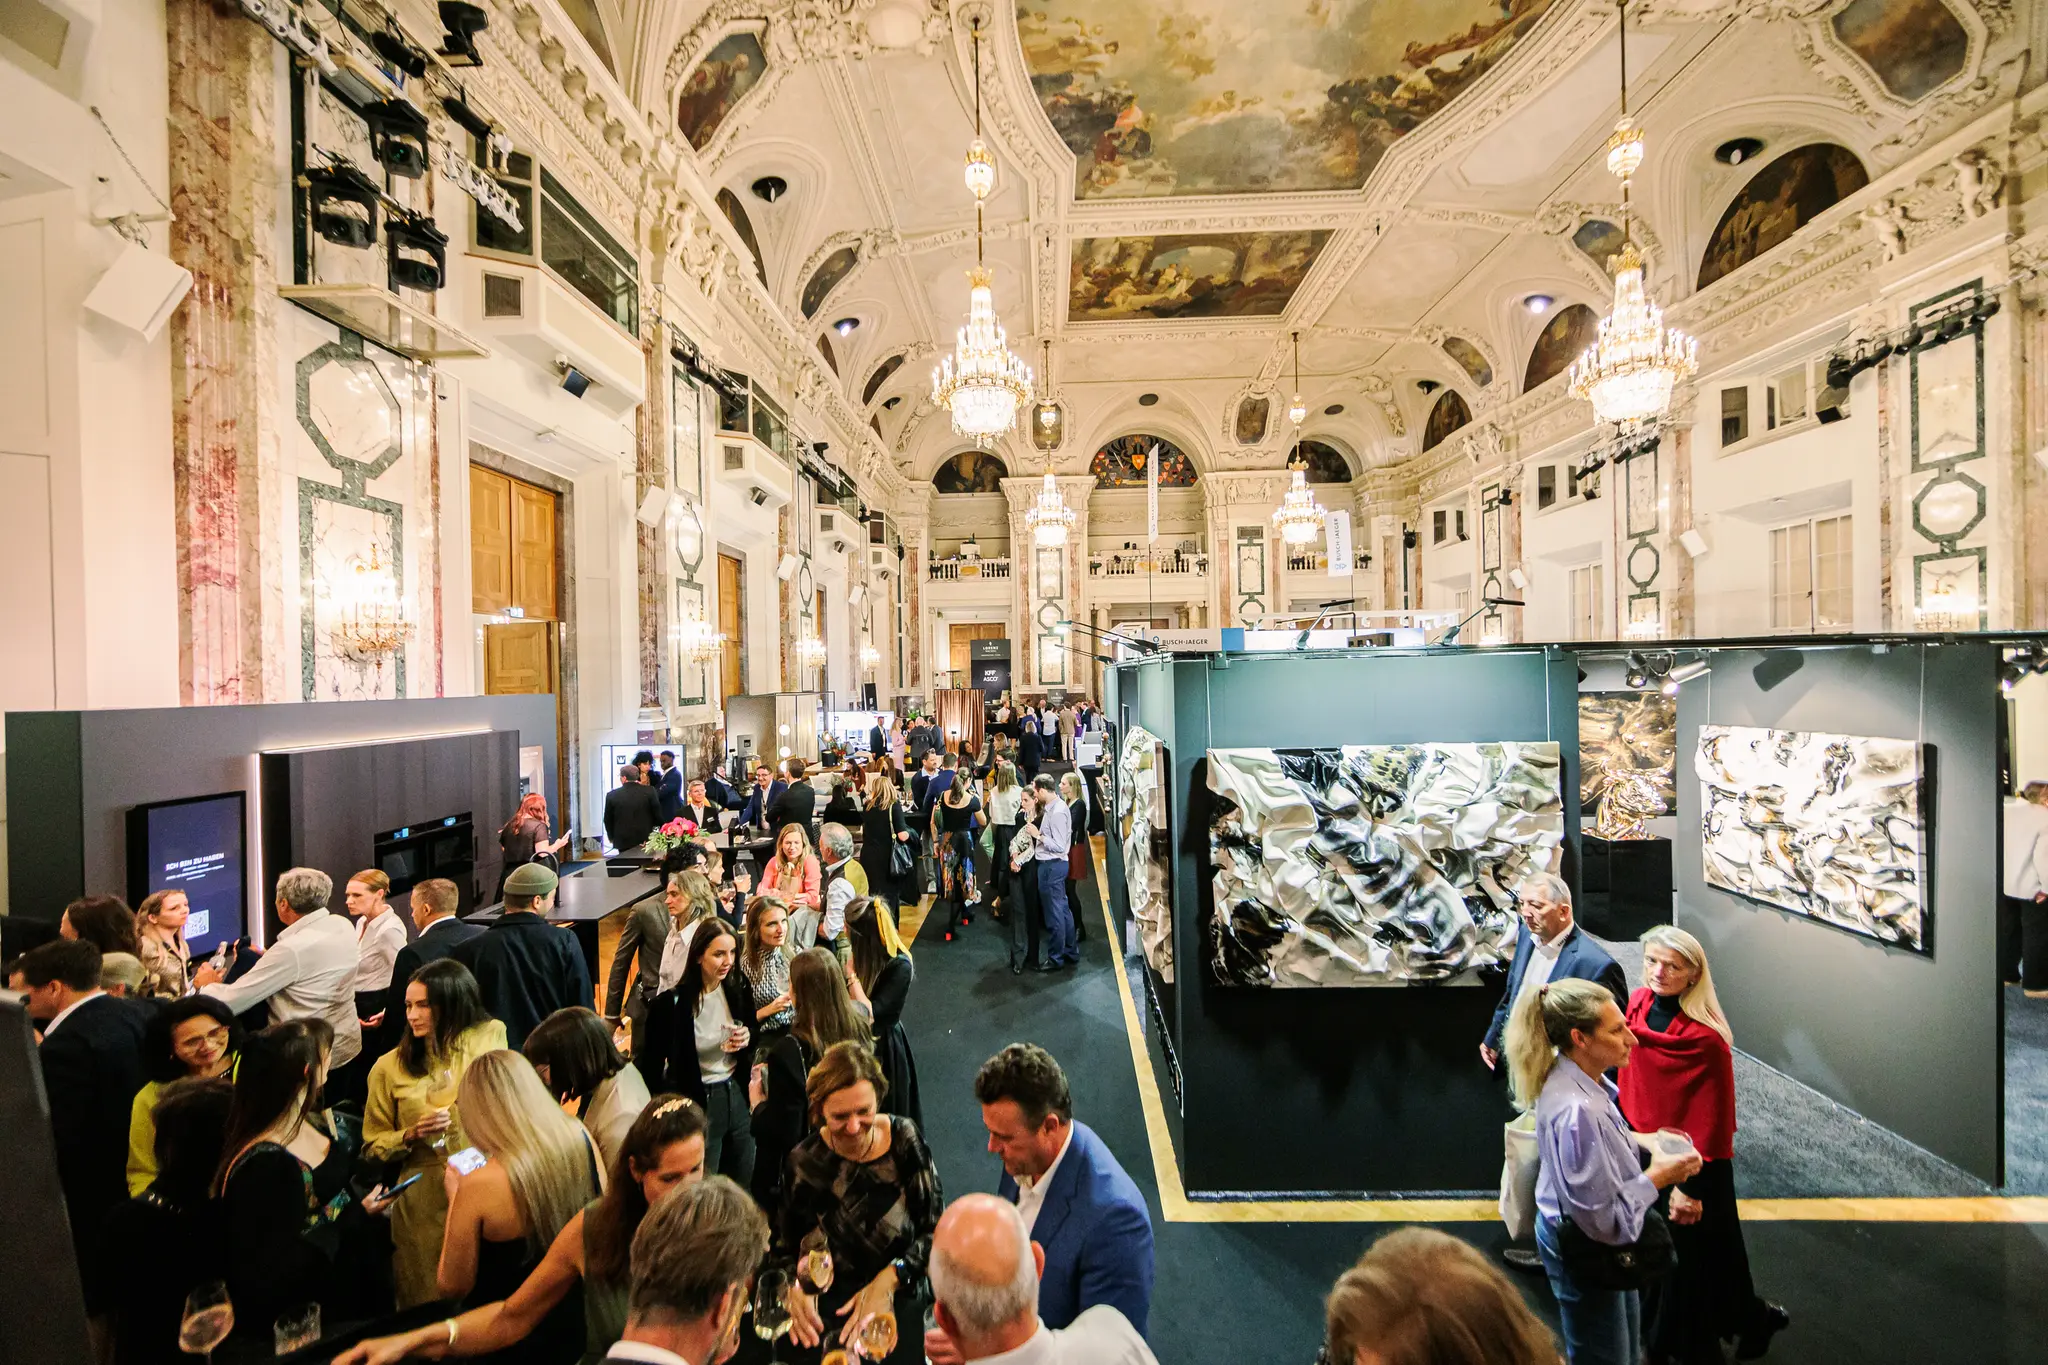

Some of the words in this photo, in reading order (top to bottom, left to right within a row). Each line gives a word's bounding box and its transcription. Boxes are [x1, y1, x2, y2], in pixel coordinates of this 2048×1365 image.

[166, 862, 178, 871] ICH
[180, 859, 193, 868] BIN
[193, 857, 202, 865] ZU
[203, 852, 224, 862] HABEN
